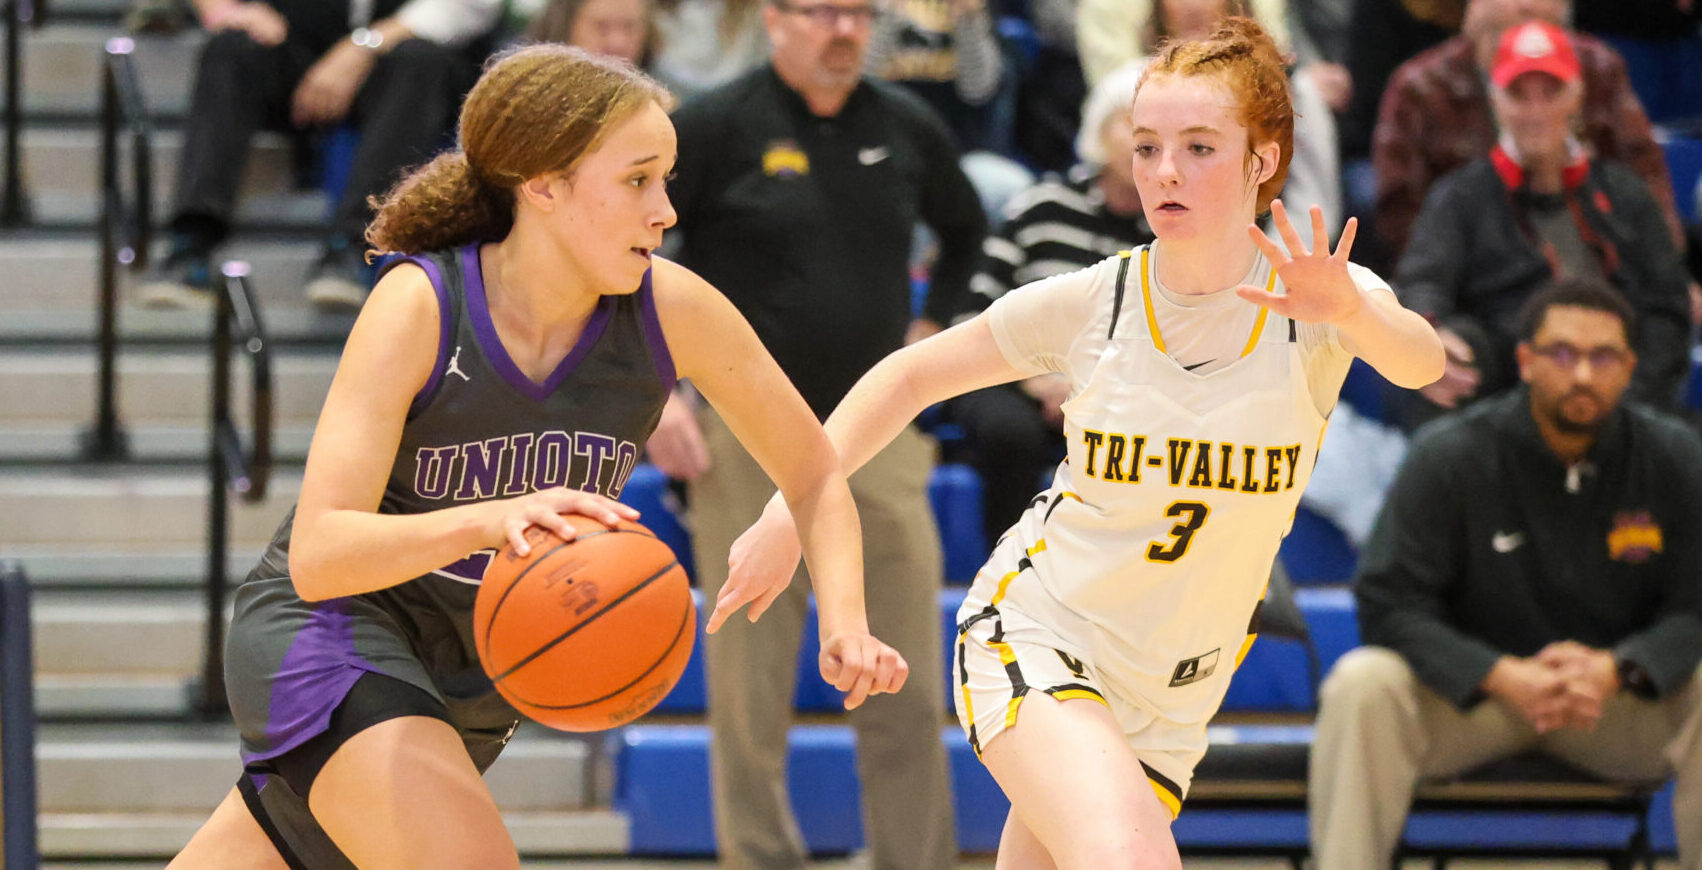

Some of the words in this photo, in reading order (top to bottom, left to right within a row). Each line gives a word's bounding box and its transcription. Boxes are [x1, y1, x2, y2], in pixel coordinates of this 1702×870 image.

[414, 430, 637, 500] UNIOTO
[1083, 428, 1302, 495] TRI-VALLEY
[1144, 499, 1211, 563] 3
